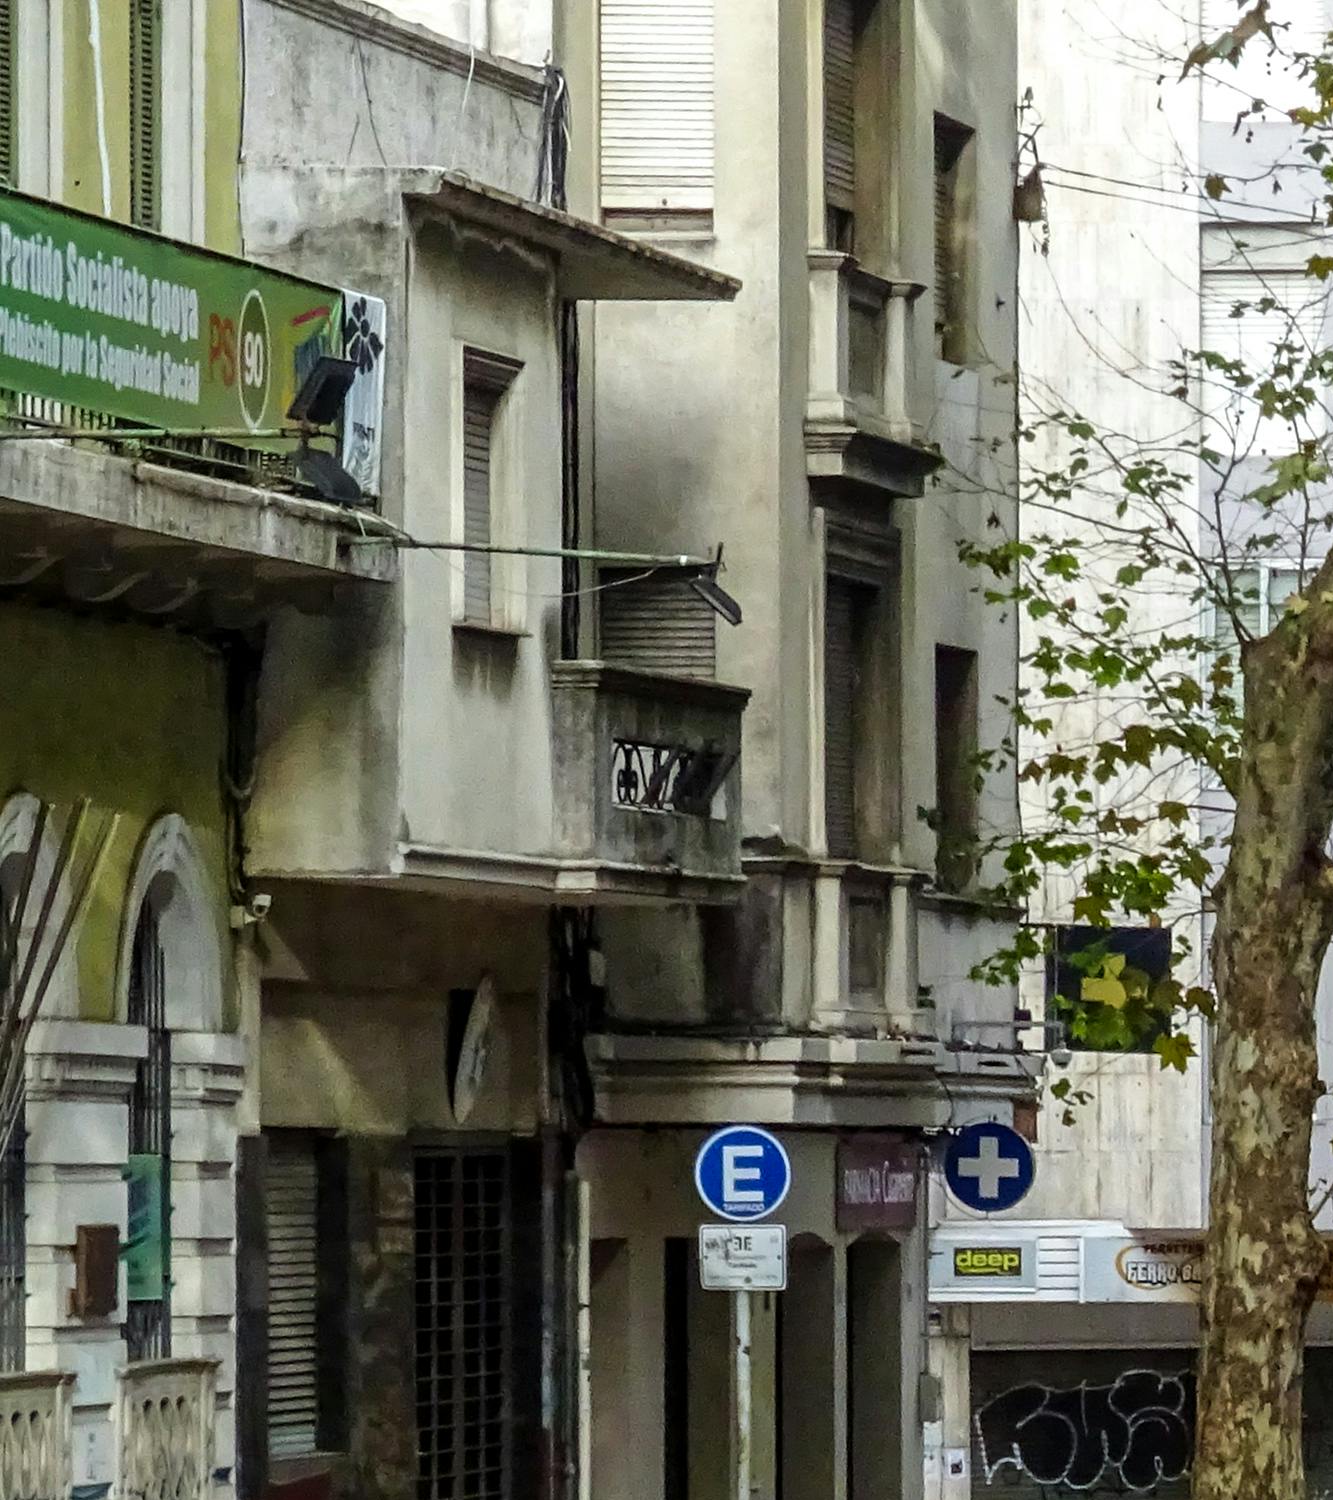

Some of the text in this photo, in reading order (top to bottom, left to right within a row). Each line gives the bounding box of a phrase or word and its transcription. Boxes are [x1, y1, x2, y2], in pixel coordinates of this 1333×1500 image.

[1, 221, 199, 343] Partido Socialista apoya
[61, 331, 85, 377] por
[85, 330, 98, 379] la
[100, 334, 162, 395] Seguridad
[162, 351, 200, 406] Social
[208, 312, 237, 389] PS
[244, 331, 264, 389] 90
[723, 1145, 764, 1202] E
[956, 1249, 1019, 1271] deep
[1127, 1262, 1176, 1283] FERRO
